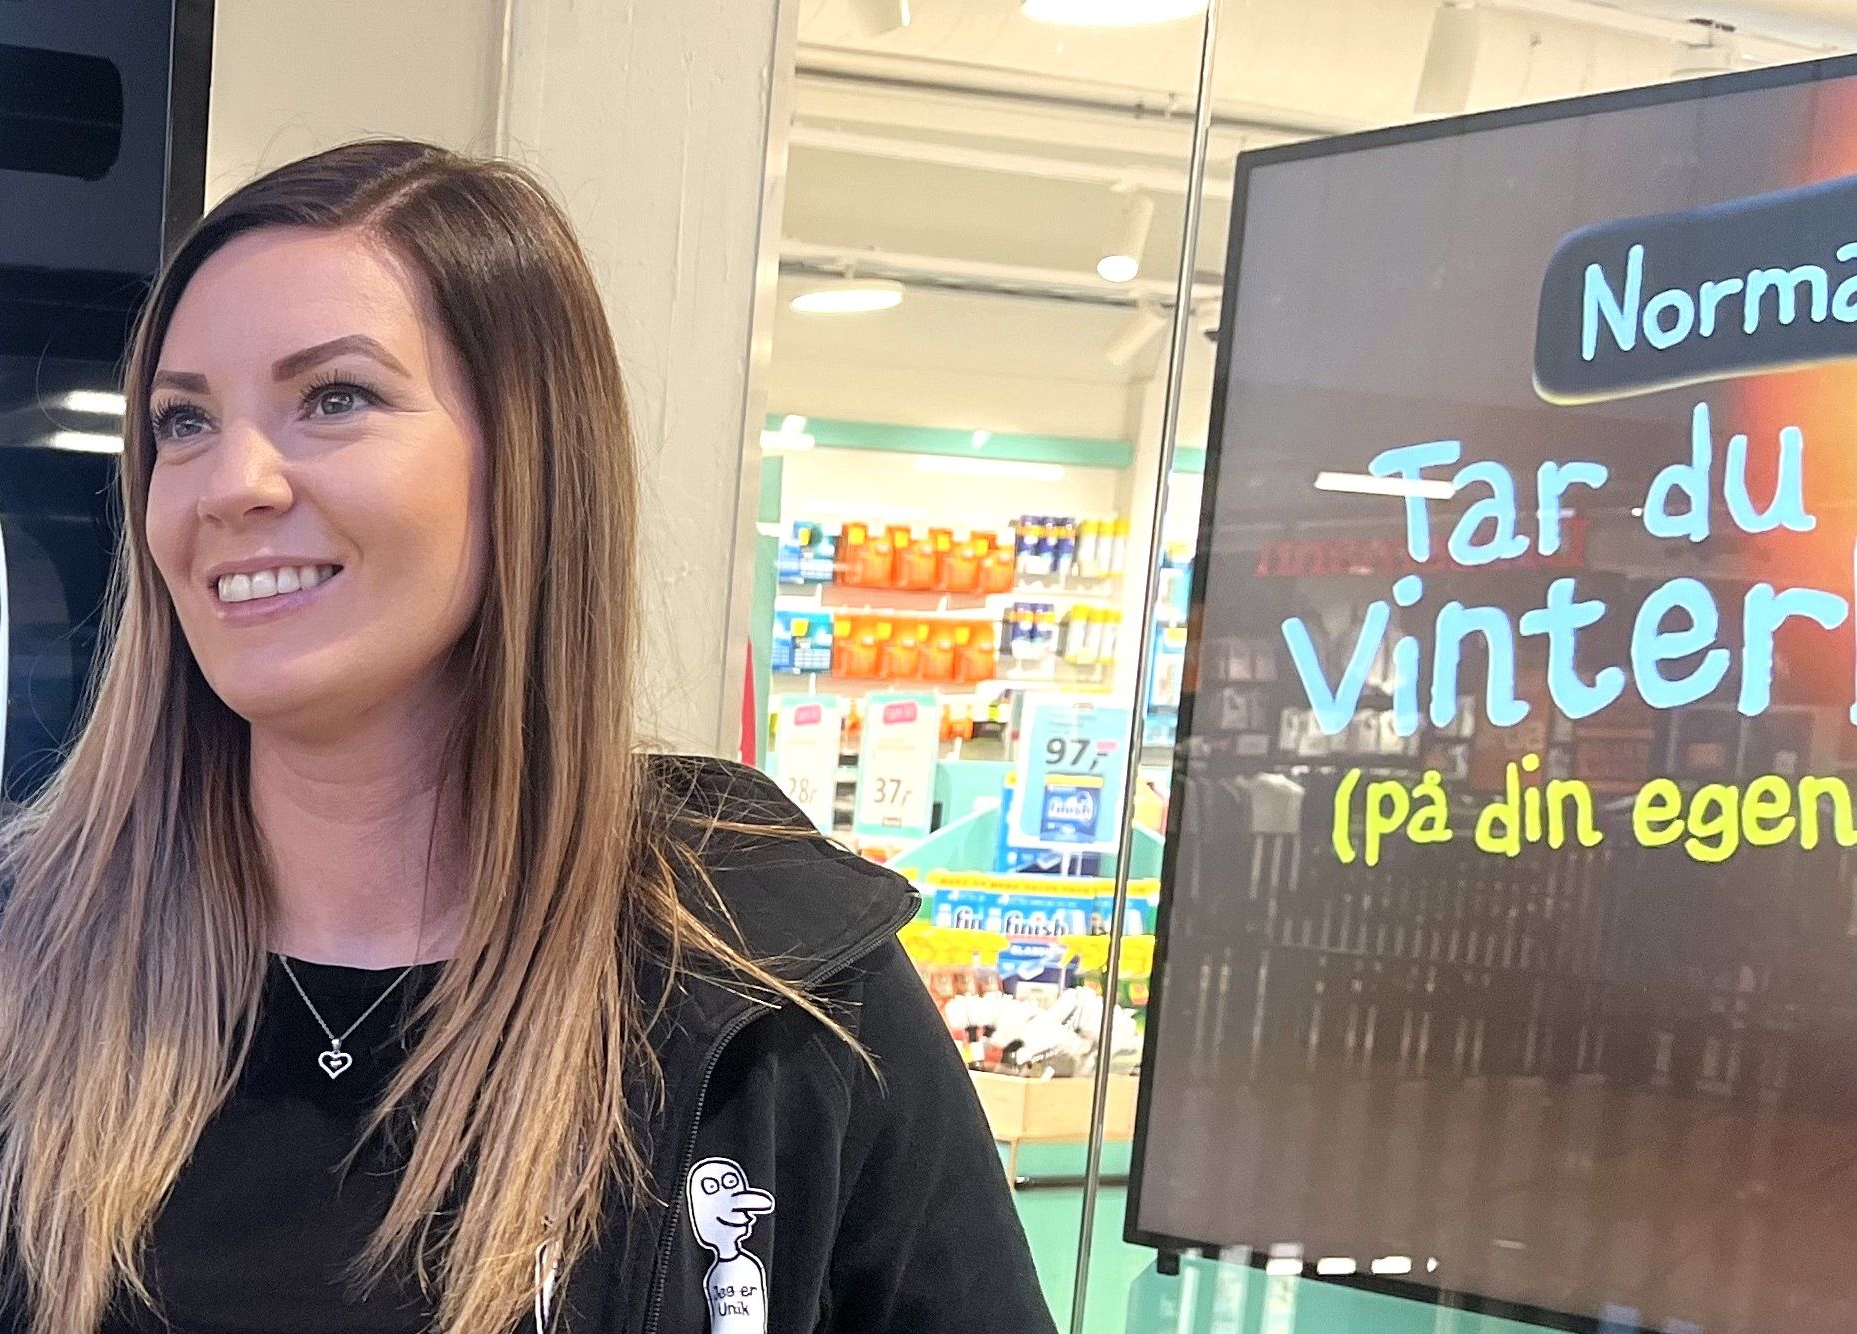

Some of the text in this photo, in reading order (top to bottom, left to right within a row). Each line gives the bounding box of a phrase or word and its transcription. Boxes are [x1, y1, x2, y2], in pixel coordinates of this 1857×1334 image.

[1367, 439, 1609, 567] Tar
[1642, 402, 1817, 543] du
[1330, 766, 1455, 867] (på
[1474, 753, 1603, 858] din
[740, 1285, 758, 1297] er
